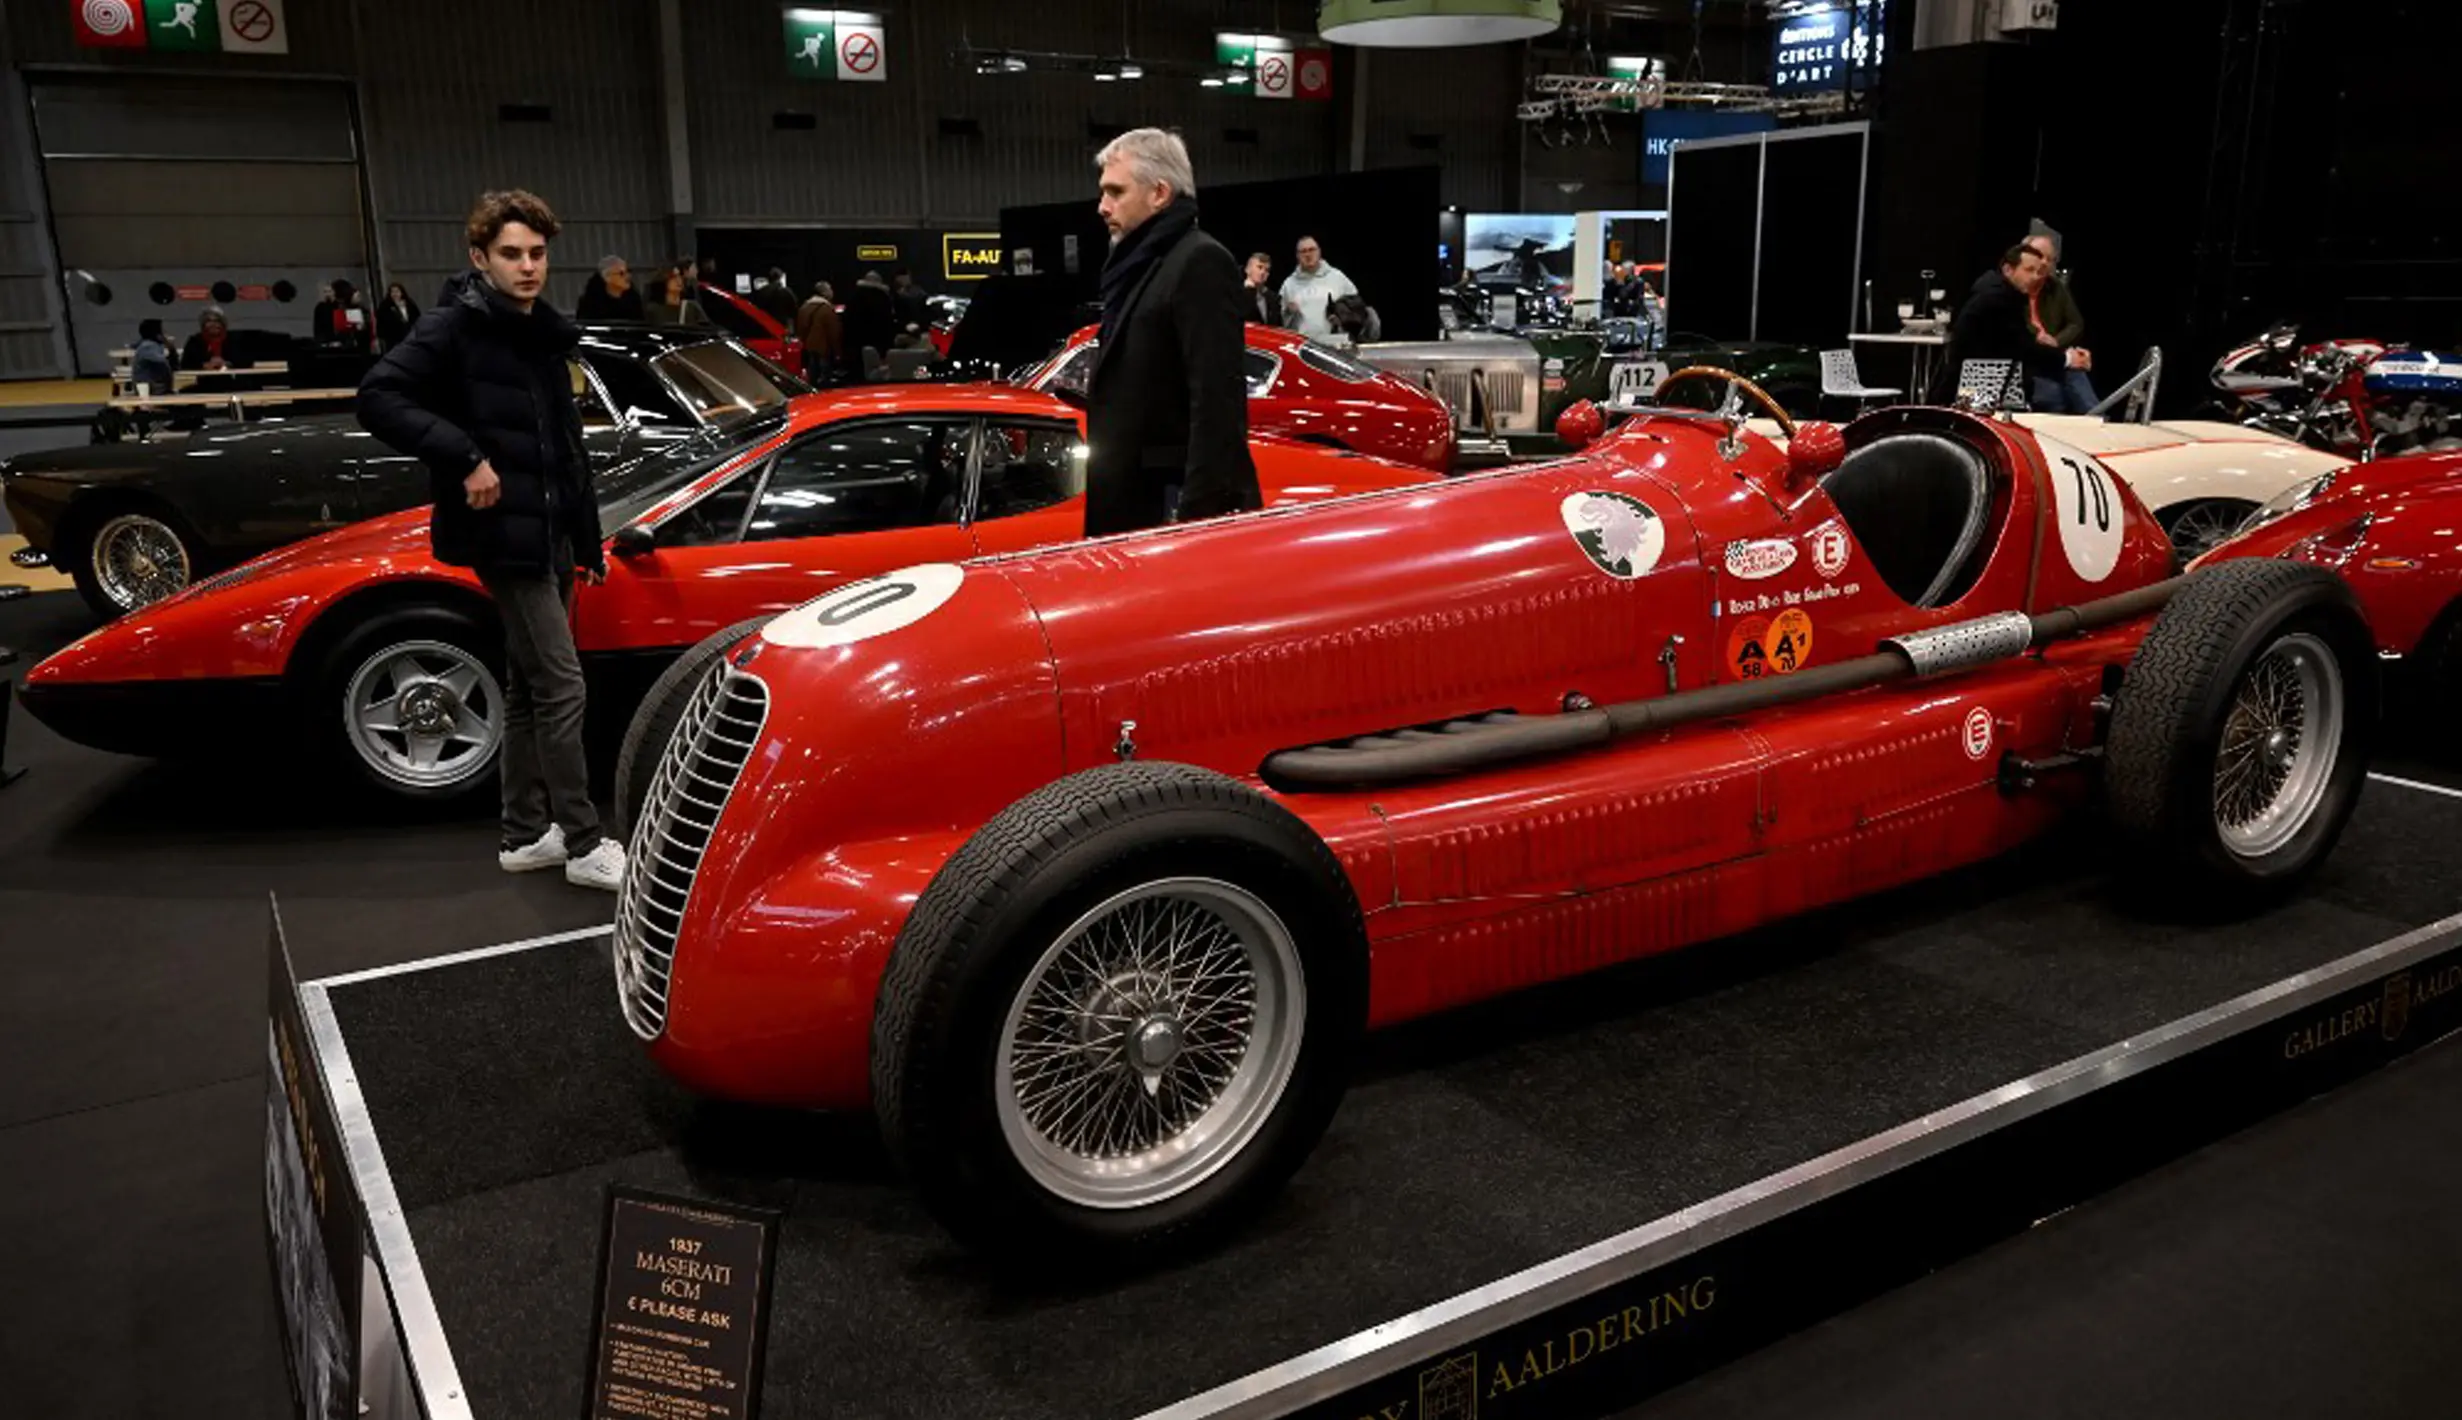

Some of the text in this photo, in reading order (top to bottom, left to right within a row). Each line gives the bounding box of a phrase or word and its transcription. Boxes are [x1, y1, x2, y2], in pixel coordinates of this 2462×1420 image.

[1778, 45, 1835, 64] CERCLE
[1776, 65, 1834, 86] D'ART
[952, 250, 1003, 264] FA-AU
[1623, 367, 1656, 387] 112
[2060, 456, 2110, 533] 70
[1823, 535, 1848, 564] E
[1737, 640, 1767, 664] A
[1742, 662, 1761, 678] 58
[2284, 998, 2380, 1059] GALLERY
[669, 1237, 702, 1256] 1937
[635, 1251, 733, 1286] MASERATI
[660, 1276, 701, 1301] 6CM
[639, 1298, 697, 1323] PLEASE
[700, 1310, 731, 1329] ASK
[1486, 1276, 1717, 1400] AALDERING
